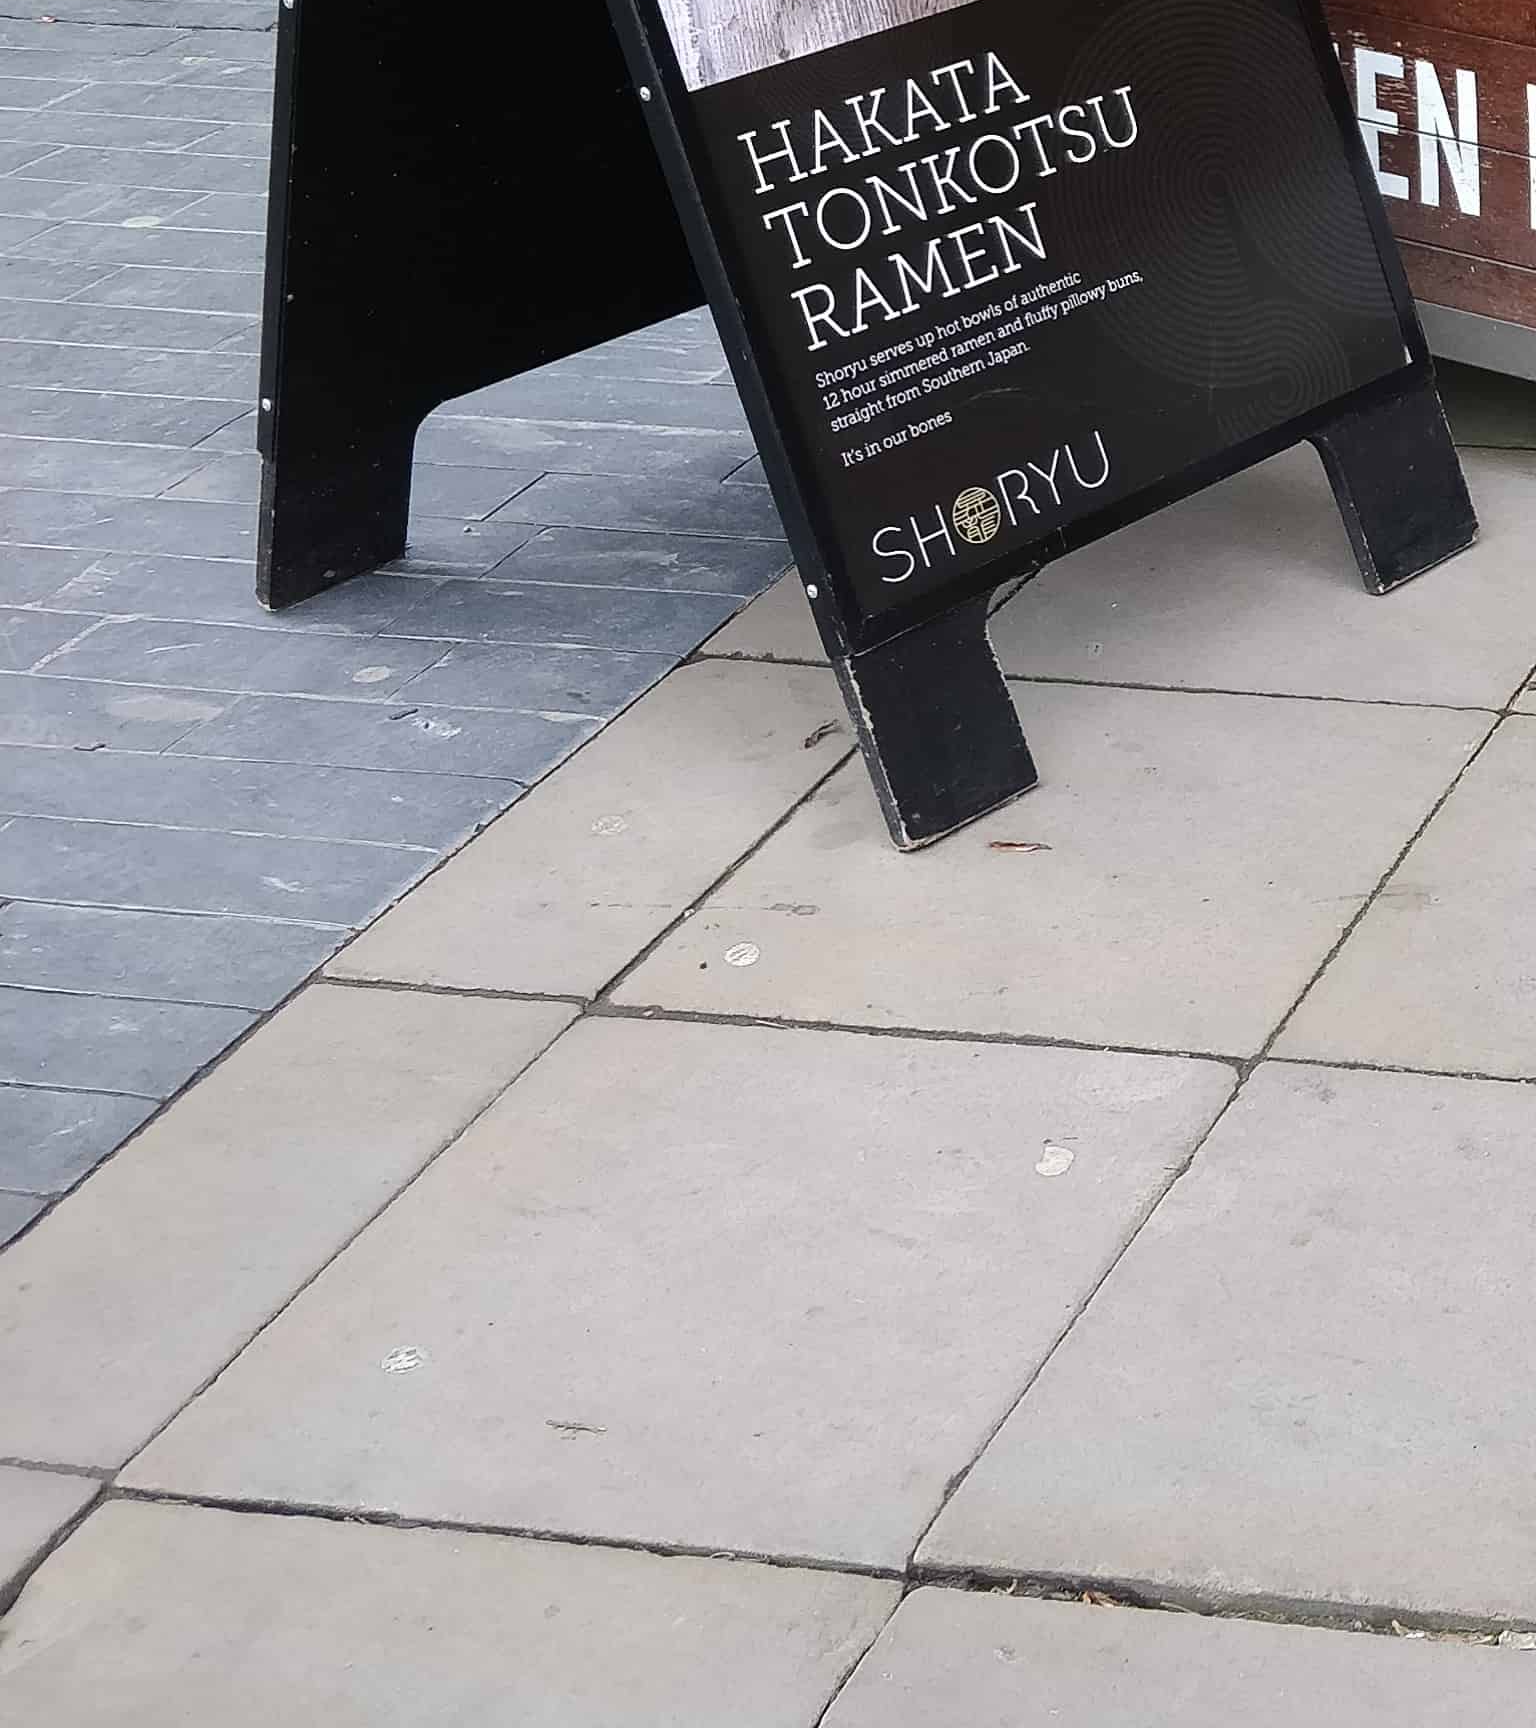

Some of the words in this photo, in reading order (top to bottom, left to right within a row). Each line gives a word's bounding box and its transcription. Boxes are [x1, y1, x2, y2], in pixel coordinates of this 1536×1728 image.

[737, 51, 1031, 195] HAKATA
[763, 85, 1139, 270] TONKOTSU
[1333, 42, 1481, 217] EN
[790, 201, 1048, 351] RAMEN
[815, 358, 868, 388] Shoryu
[870, 339, 914, 366] serves
[916, 328, 936, 350] up
[936, 319, 961, 340] hot
[960, 302, 1002, 331] bowls
[1004, 294, 1021, 313] of
[1020, 272, 1082, 306] authentic
[822, 393, 841, 411] 12
[842, 379, 877, 403] hour
[878, 348, 949, 388] simmered
[950, 332, 995, 358] ramen
[997, 316, 1024, 339] and
[1025, 303, 1059, 331] fluffy
[1061, 283, 1106, 316] pillowy
[1109, 270, 1144, 292] buns,
[831, 400, 885, 432] straight
[885, 386, 921, 409] from
[922, 358, 986, 393] Southern
[987, 340, 1031, 367] Japan.
[840, 446, 864, 467] It's
[864, 441, 882, 458] in
[883, 429, 909, 449] our
[908, 410, 953, 438] bones
